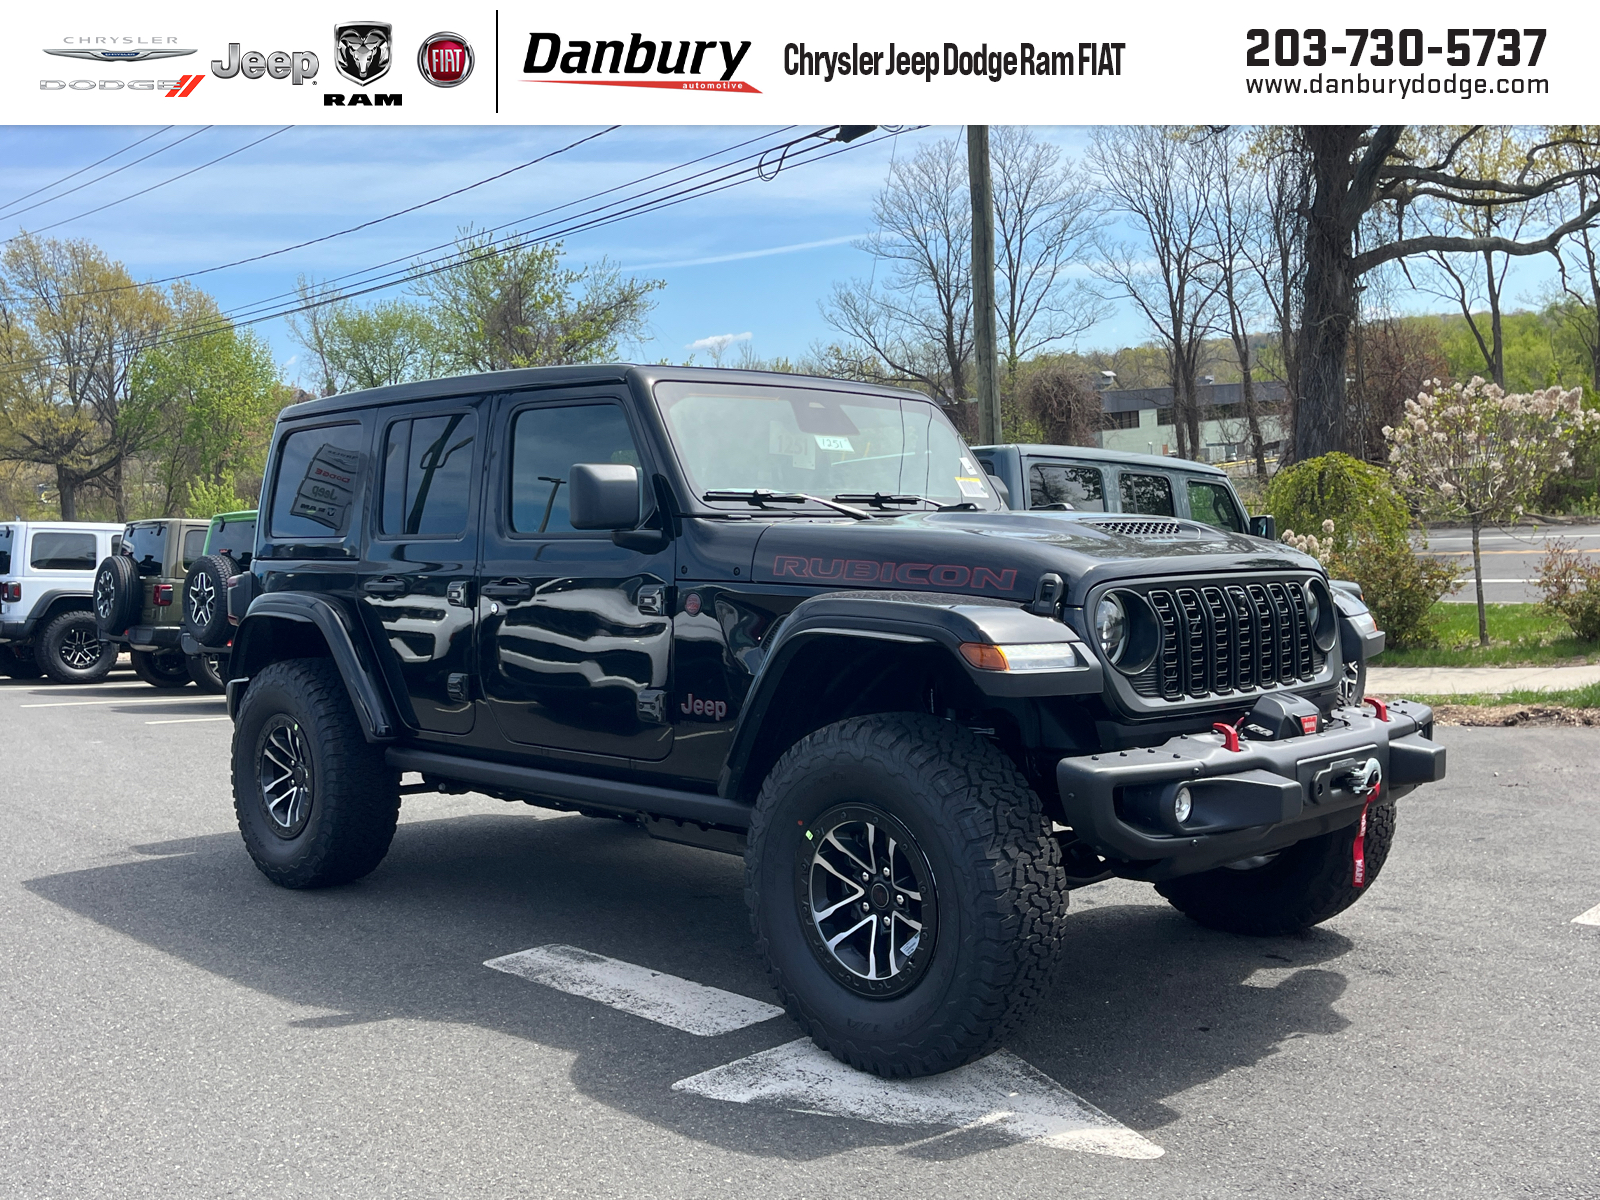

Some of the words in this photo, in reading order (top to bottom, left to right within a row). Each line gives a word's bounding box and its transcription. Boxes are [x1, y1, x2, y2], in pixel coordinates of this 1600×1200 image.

[822, 438, 843, 449] 1251
[773, 556, 1018, 590] RUBICON
[681, 694, 727, 721] Jeep
[1355, 860, 1364, 883] WARN
